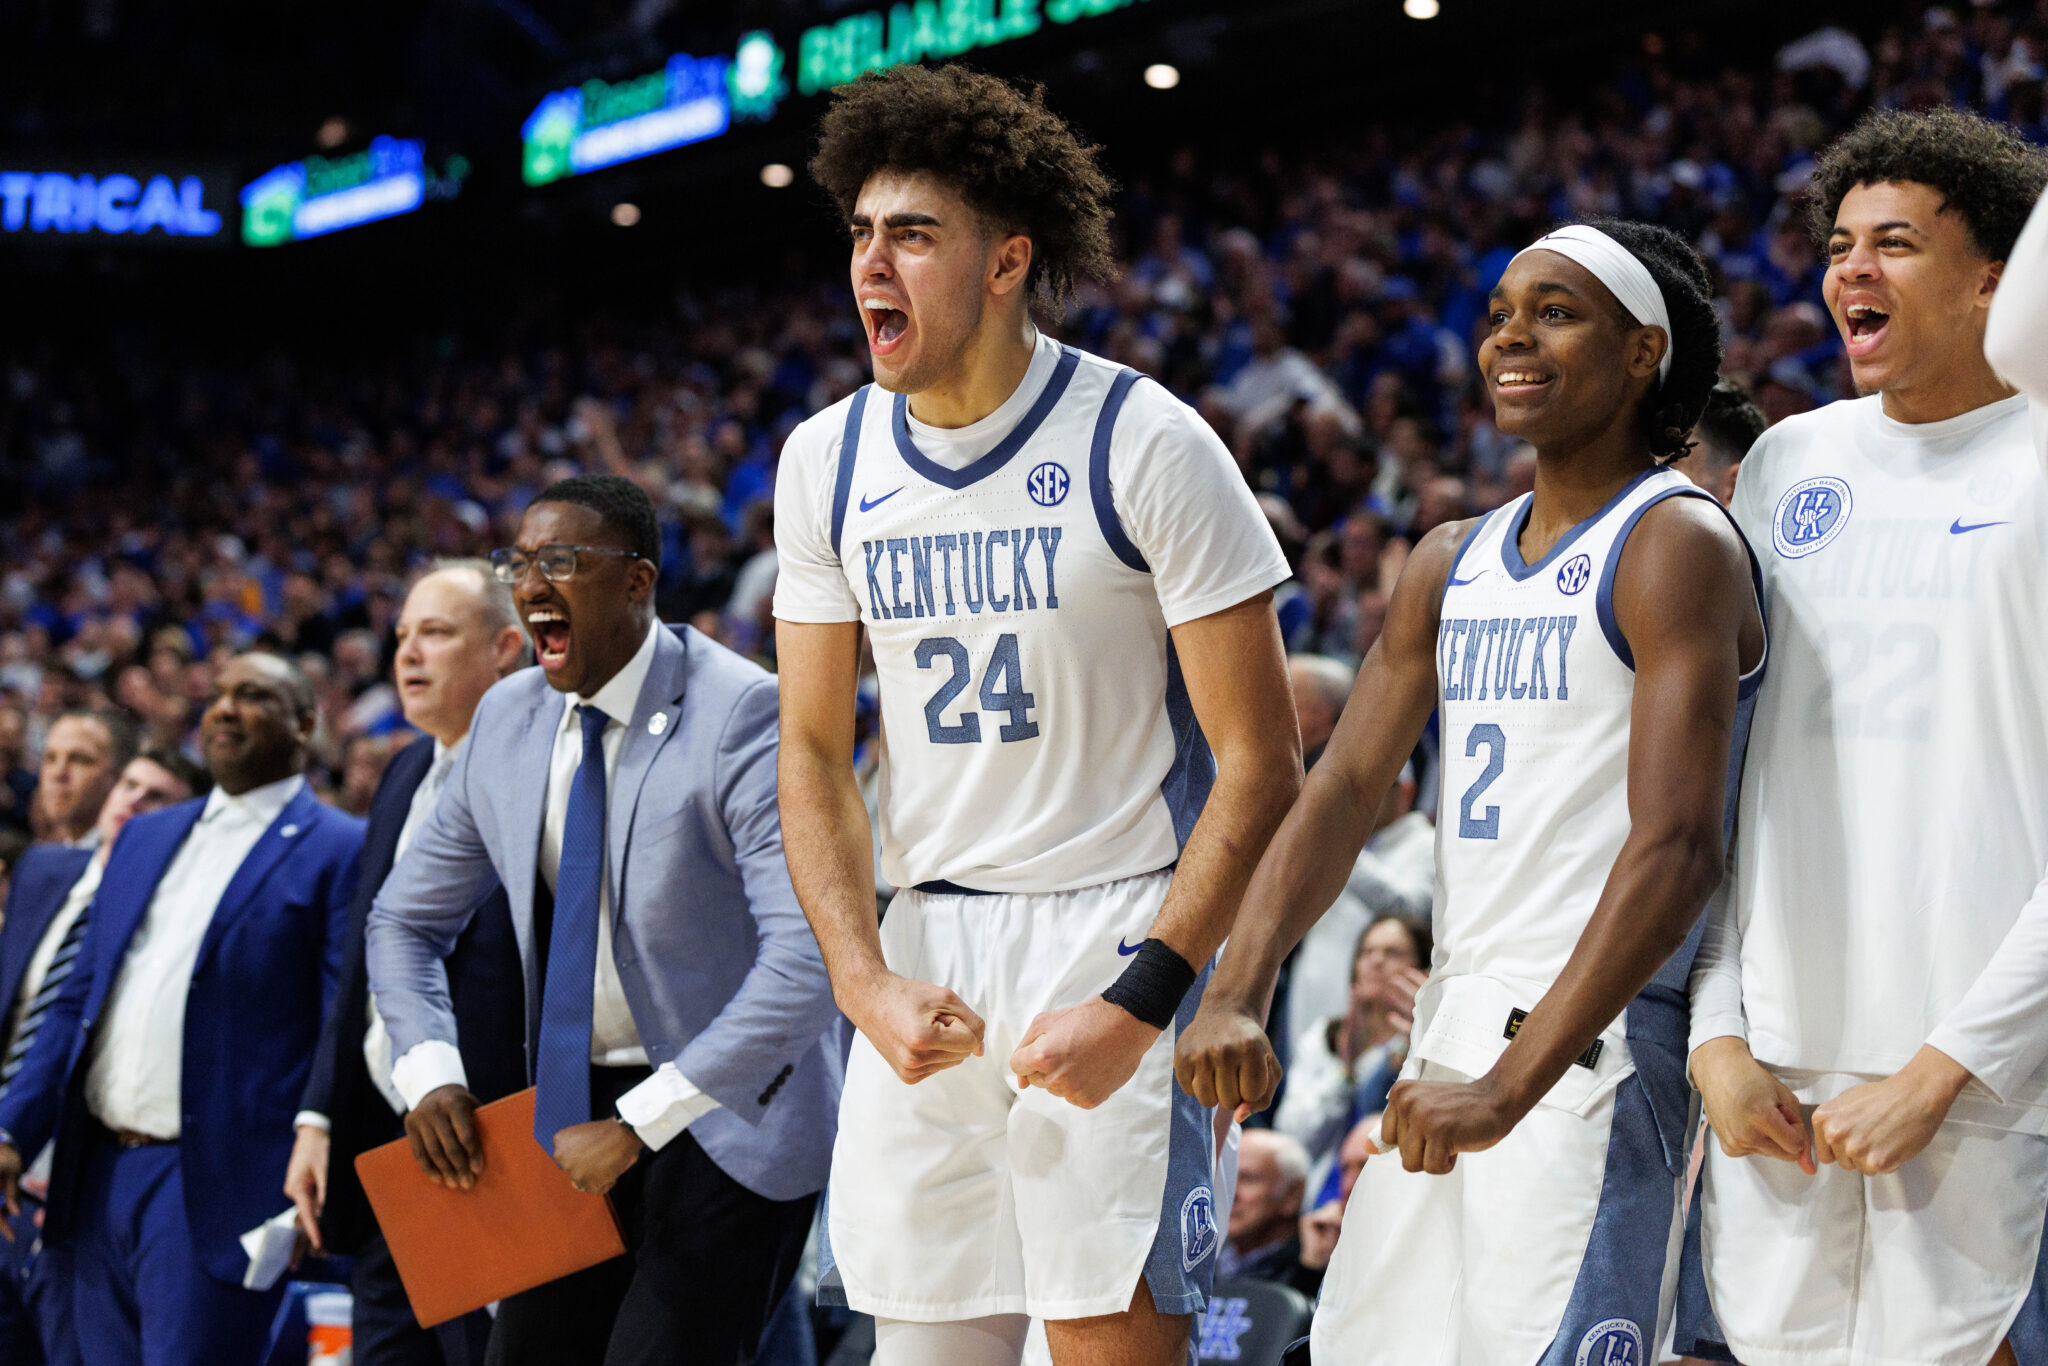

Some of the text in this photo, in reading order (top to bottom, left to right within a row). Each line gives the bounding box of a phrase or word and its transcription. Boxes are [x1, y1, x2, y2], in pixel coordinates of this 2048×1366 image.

[1030, 463, 1069, 504] SEC
[862, 526, 1062, 620] KENTUCKY
[1558, 554, 1591, 595] SEC
[914, 634, 1039, 744] 24
[1440, 615, 1577, 701] KENTUCKY
[1459, 723, 1506, 839] 2
[1587, 1321, 1625, 1343] KENTUCKY
